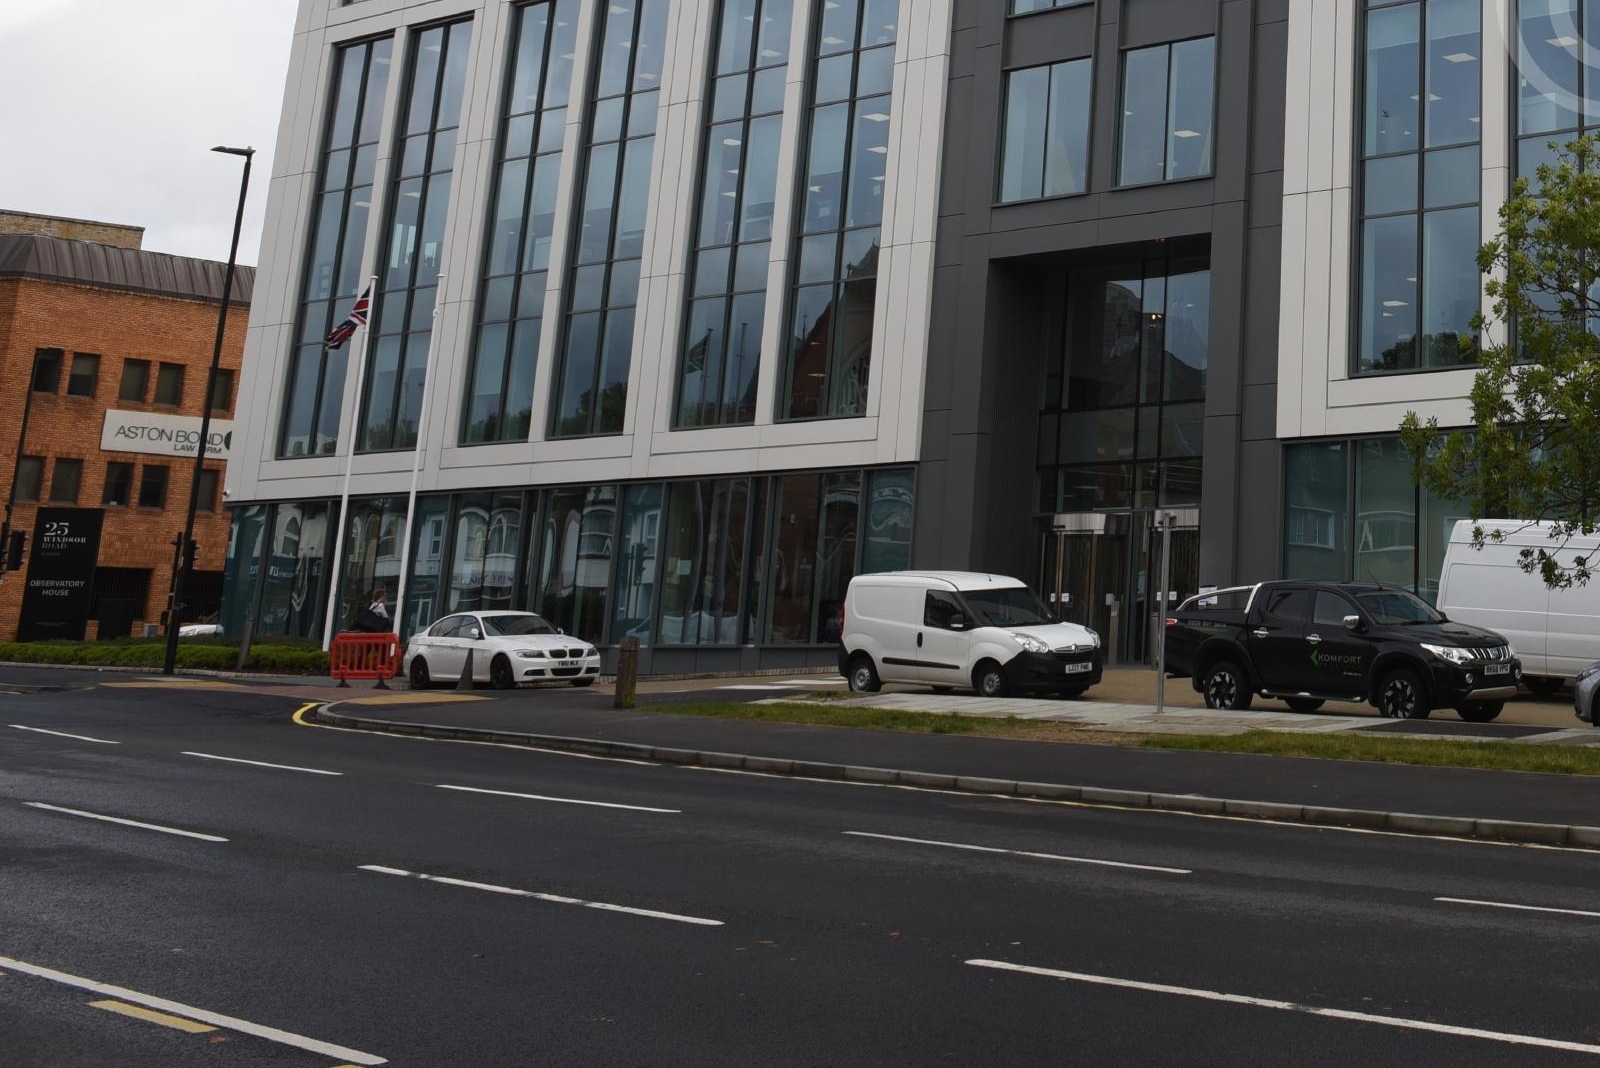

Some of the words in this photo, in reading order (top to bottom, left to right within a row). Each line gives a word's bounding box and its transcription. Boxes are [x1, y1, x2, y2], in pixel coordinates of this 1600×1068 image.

[115, 425, 173, 442] ASTON
[173, 444, 196, 452] LAW
[44, 521, 70, 536] 25
[42, 536, 87, 544] WINDSOR
[30, 579, 85, 588] OBSERVATORY
[42, 589, 70, 597] HOUSE
[1318, 653, 1362, 664] KOMFORT
